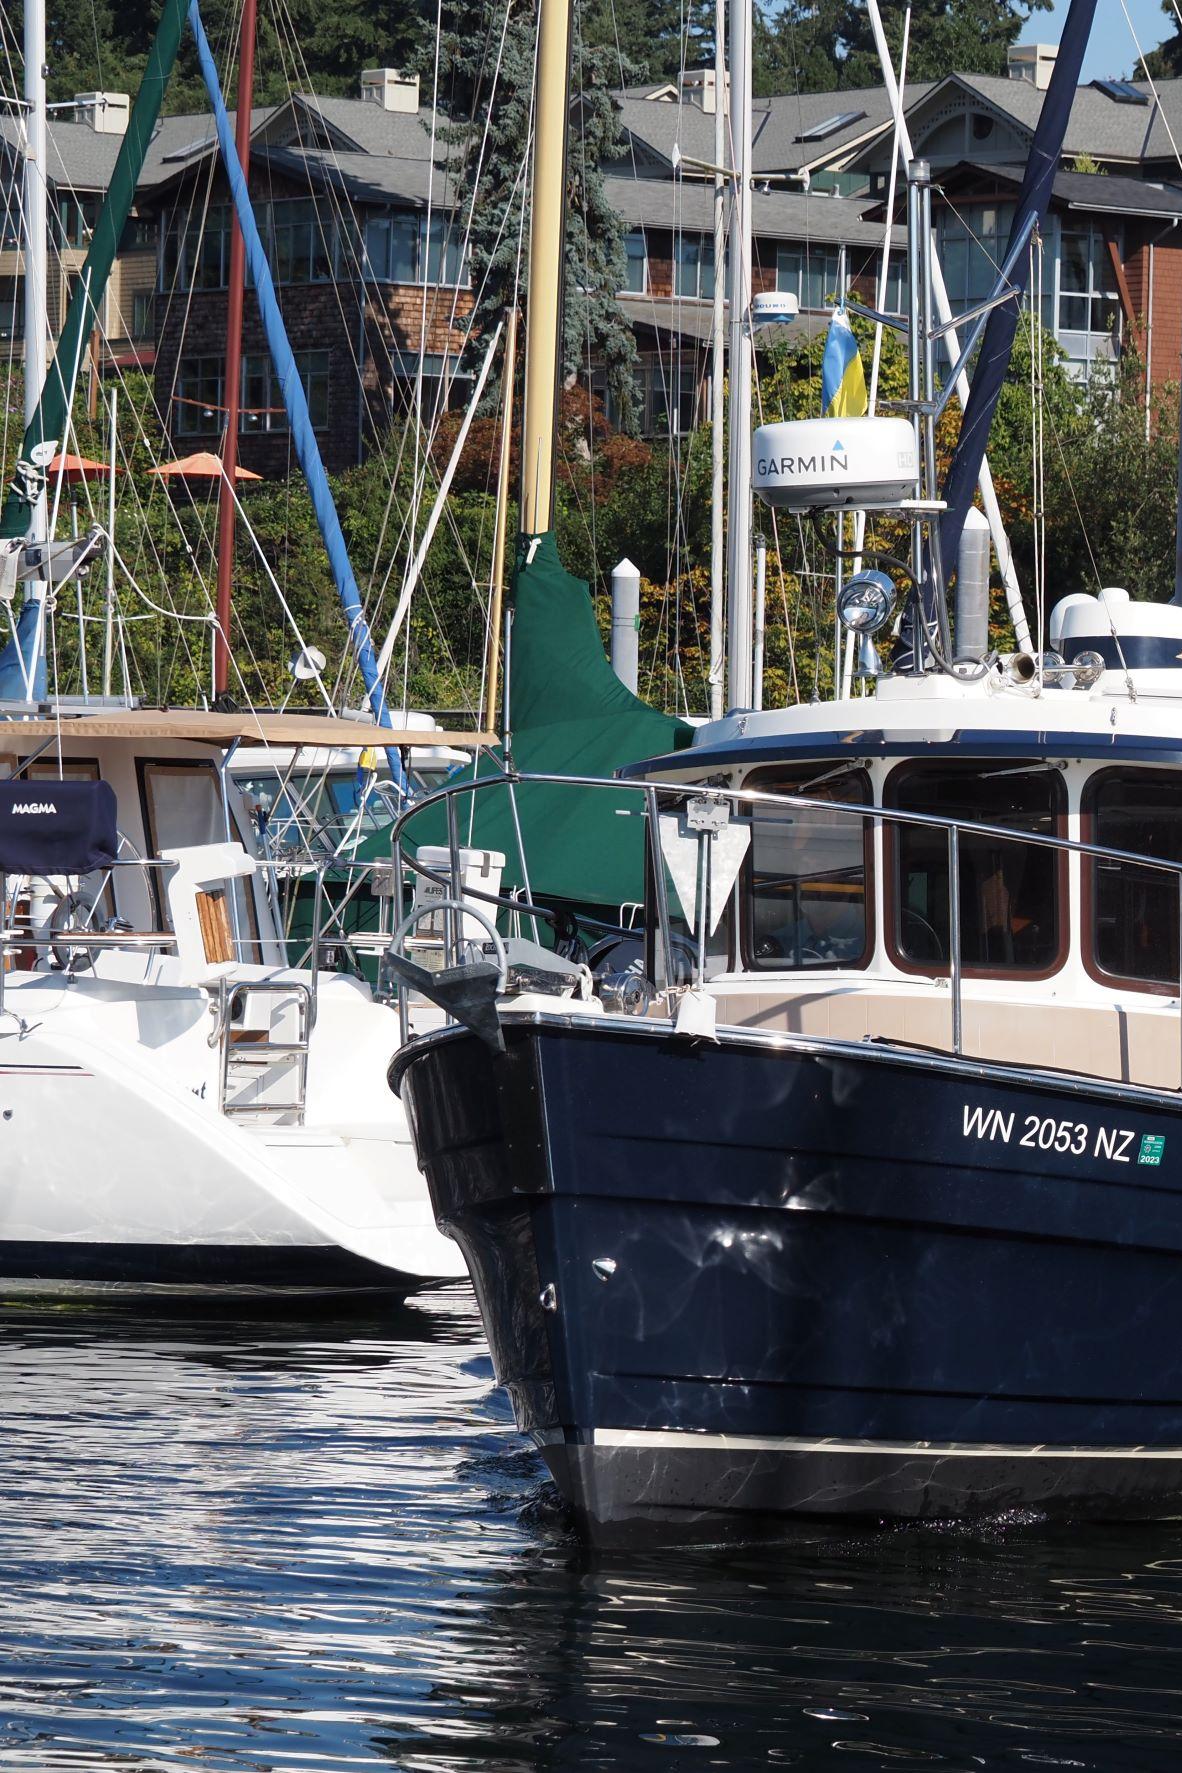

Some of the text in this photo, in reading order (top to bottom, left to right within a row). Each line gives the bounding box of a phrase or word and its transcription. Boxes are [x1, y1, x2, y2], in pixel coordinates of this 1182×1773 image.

[758, 454, 848, 476] GARMIN
[11, 802, 57, 814] MAGMA
[963, 1105, 1136, 1162] WN 2053 NZ
[1140, 1155, 1160, 1164] 2023
